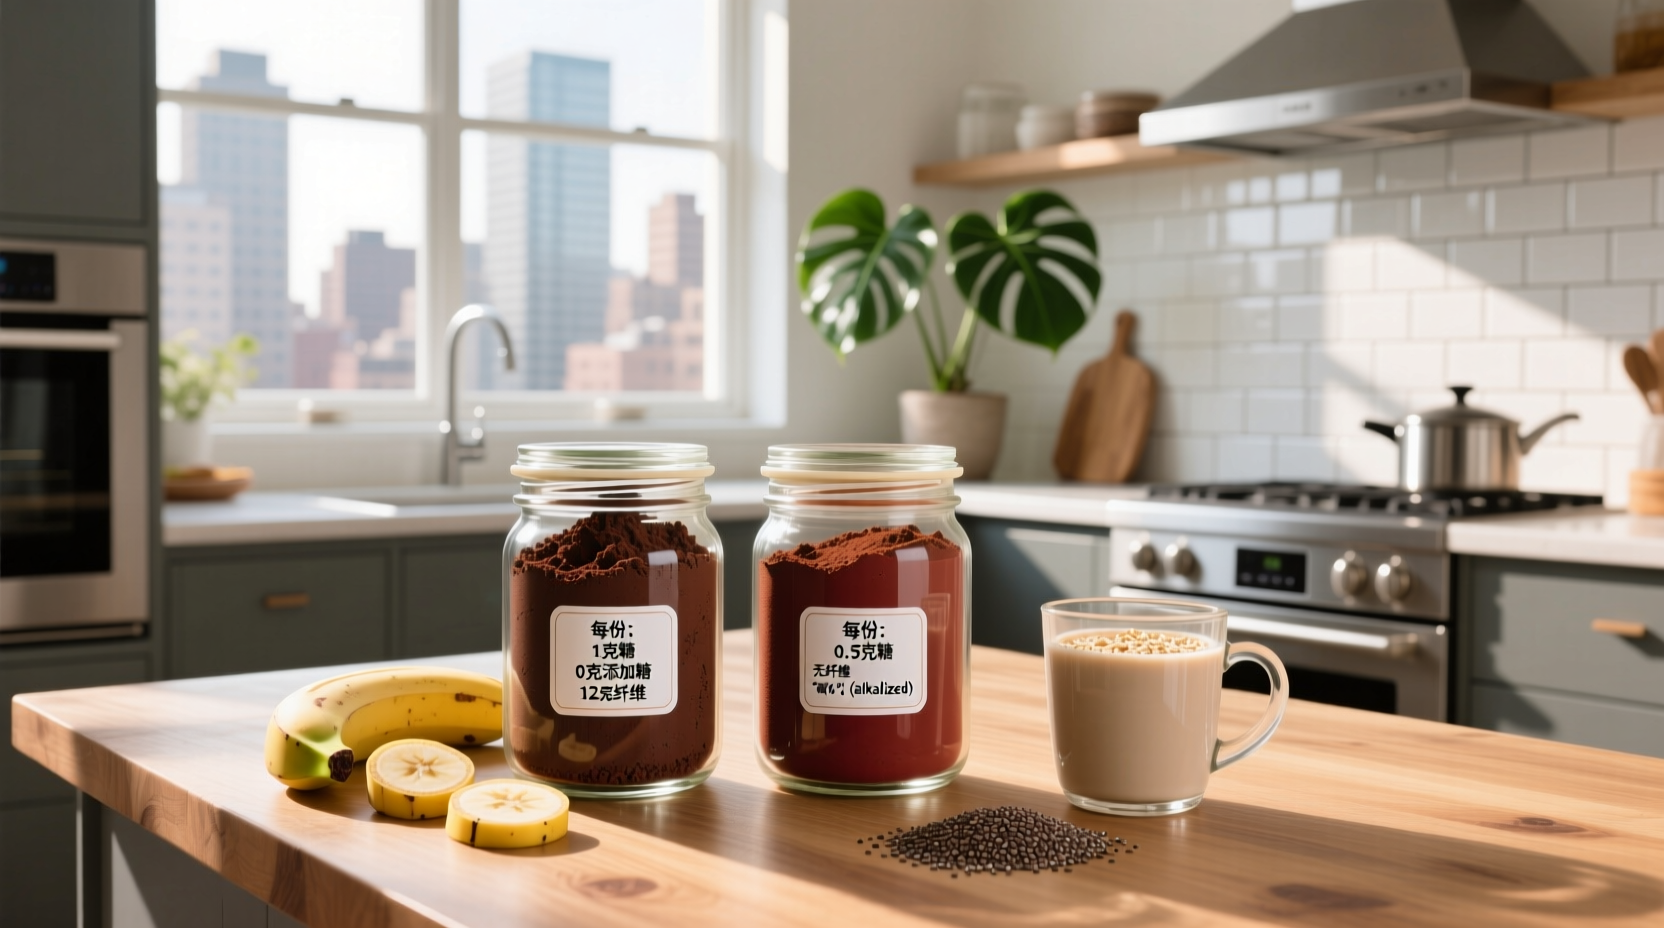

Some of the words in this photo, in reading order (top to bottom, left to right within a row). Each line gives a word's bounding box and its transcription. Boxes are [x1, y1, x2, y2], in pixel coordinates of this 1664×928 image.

[592, 642, 635, 659] 1克糖
[834, 642, 894, 661] 0.5克糖
[850, 681, 914, 698] (alkalized)
